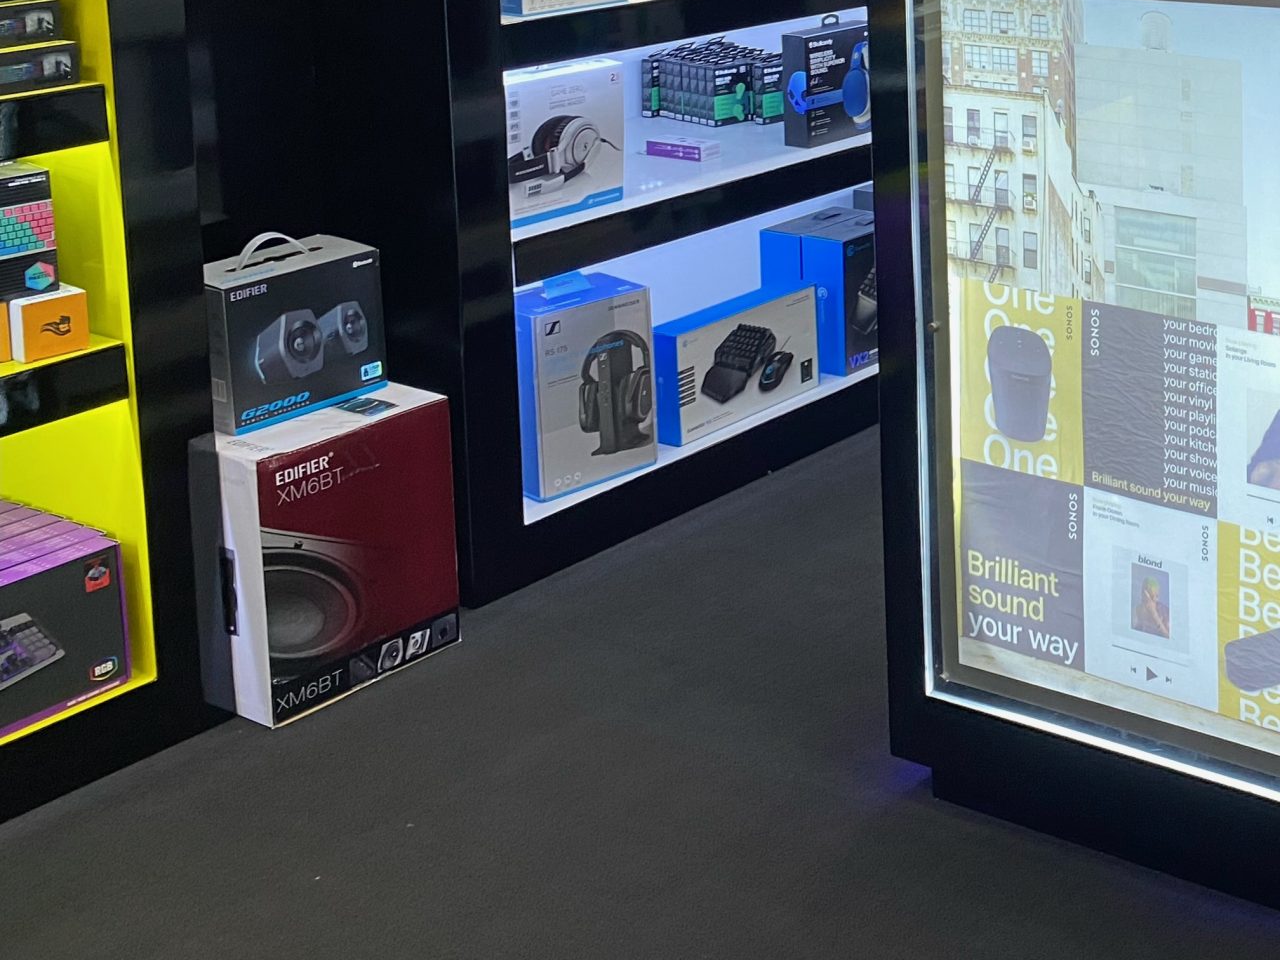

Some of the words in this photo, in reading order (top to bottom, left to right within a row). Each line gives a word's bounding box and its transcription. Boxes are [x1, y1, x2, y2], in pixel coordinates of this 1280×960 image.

[229, 283, 268, 303] EDIFIER
[1090, 308, 1100, 356] SONOS
[1163, 318, 1187, 331] your
[1163, 332, 1187, 345] your
[850, 351, 869, 369] VX2
[1163, 346, 1187, 359] your
[1163, 361, 1187, 374] your
[1163, 376, 1187, 389] your
[241, 391, 310, 420] G2000
[1163, 390, 1187, 403] your
[1188, 393, 1213, 410] vinyl
[1163, 404, 1187, 417] your
[1163, 419, 1187, 432] your
[1163, 433, 1187, 446] your
[1189, 437, 1218, 453] kitch
[983, 433, 1059, 479] One
[1163, 447, 1187, 460] your
[1163, 461, 1187, 475] your
[277, 466, 344, 507] XM6BT
[1091, 471, 1128, 491] Brilliant
[1129, 480, 1161, 499] sound
[1162, 490, 1188, 505] your
[1189, 497, 1211, 512] way
[1163, 476, 1187, 489] your
[1068, 493, 1078, 540] SONOS
[1201, 525, 1209, 562] SONOS
[1137, 554, 1163, 569] blond
[967, 549, 1059, 597] Brilliant
[968, 583, 1044, 622] sound
[968, 611, 1022, 645] your
[1028, 629, 1079, 665] way
[94, 659, 114, 676] RGB
[276, 668, 343, 714] XM6BT
